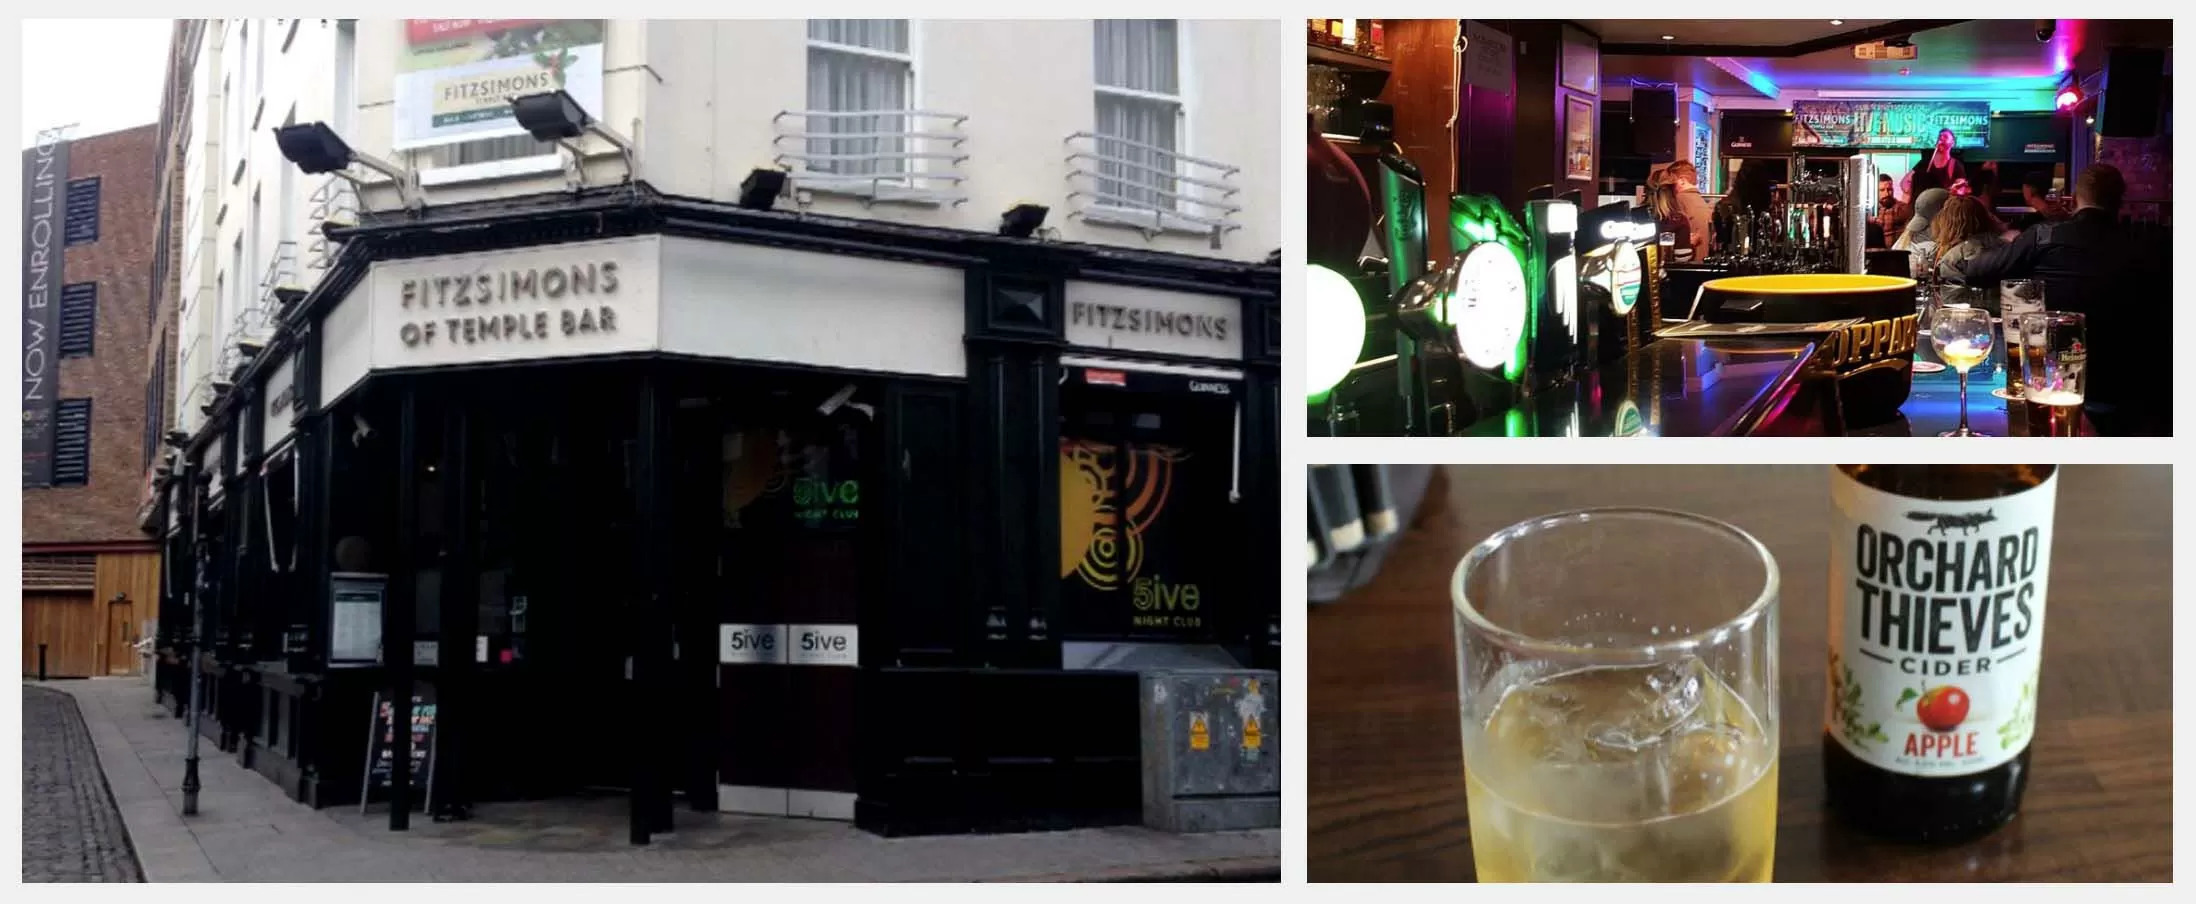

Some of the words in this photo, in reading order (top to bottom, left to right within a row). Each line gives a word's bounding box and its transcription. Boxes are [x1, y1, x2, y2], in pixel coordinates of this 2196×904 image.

[444, 71, 549, 101] FITZSIMONS
[1795, 113, 1851, 125] FITZSIMONS
[1881, 109, 1927, 135] MUSIC
[1929, 114, 1988, 126] FITZSIMONS
[28, 128, 56, 309] ENROLLING
[401, 260, 619, 309] FITZSIMONS
[400, 321, 436, 347] OF
[444, 310, 549, 344] TEMPLE
[559, 305, 617, 337] BAR
[1072, 302, 1230, 341] FITZSIMONS
[24, 319, 46, 400] NOW
[1857, 524, 2039, 593] ORCHARD
[1133, 573, 1200, 611] 5ive
[1856, 578, 2034, 655] THIEVES
[731, 629, 775, 651] 5ive
[801, 631, 847, 651] 5ive
[1901, 656, 1991, 677] CIDER
[1904, 731, 1979, 758] APPLE
